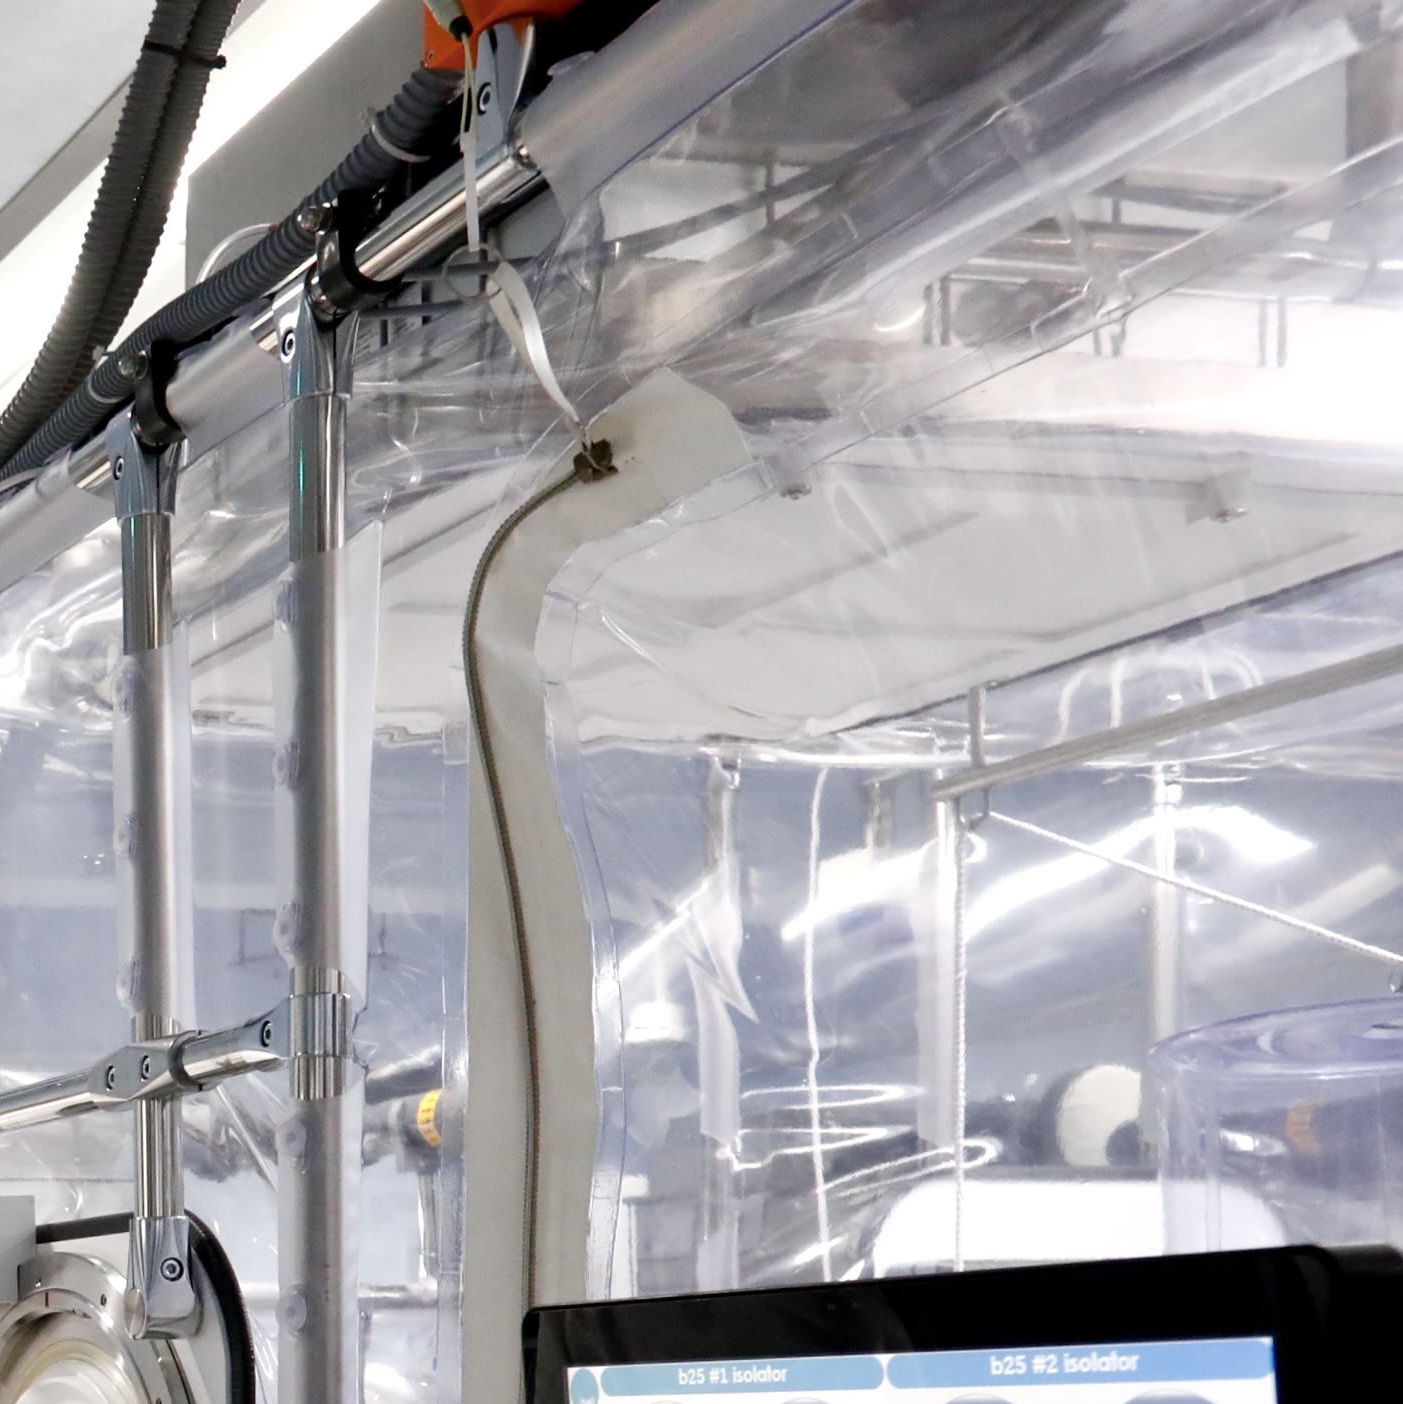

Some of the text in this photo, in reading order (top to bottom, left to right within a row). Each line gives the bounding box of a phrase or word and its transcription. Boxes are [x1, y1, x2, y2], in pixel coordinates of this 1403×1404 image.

[679, 1364, 787, 1385] b25 #1 isolator
[990, 1352, 1140, 1376] b25 #2 isolator
